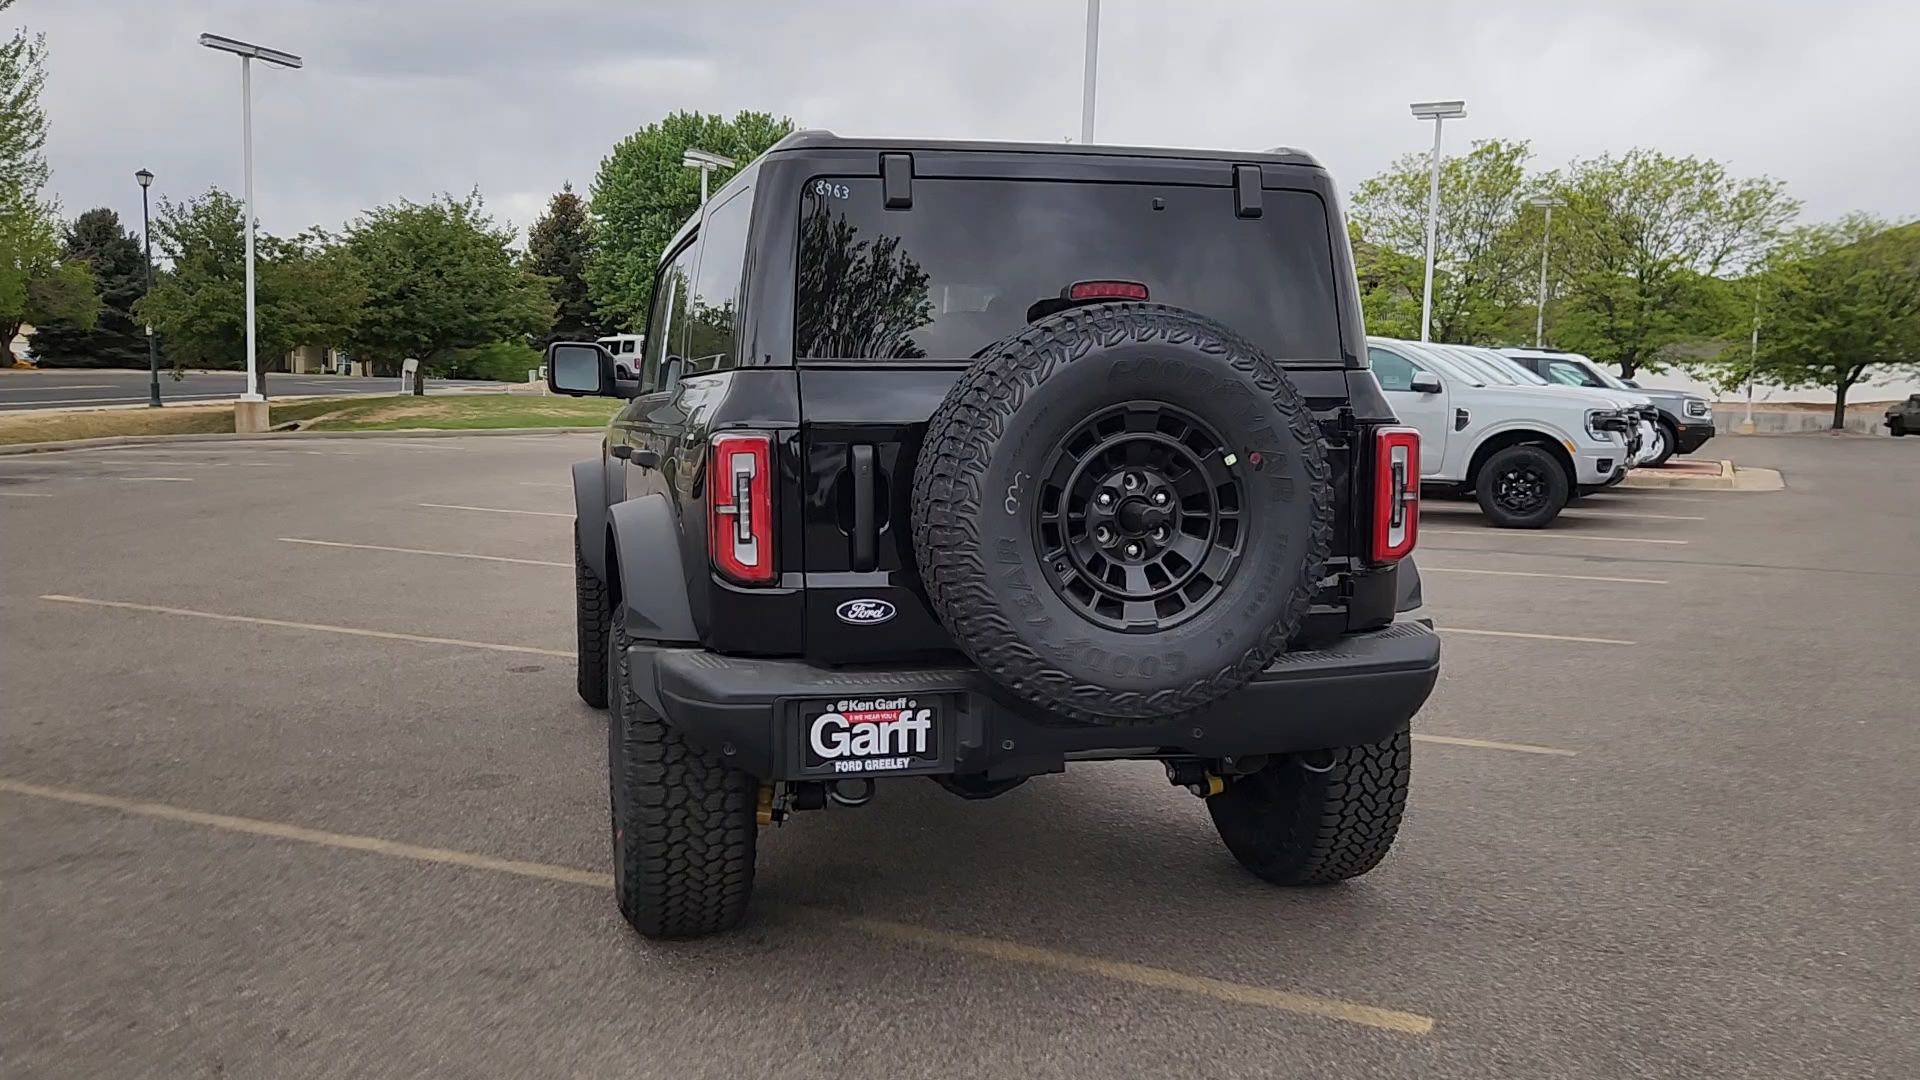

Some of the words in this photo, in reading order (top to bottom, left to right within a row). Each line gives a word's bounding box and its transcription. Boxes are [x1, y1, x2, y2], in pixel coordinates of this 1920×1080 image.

[815, 180, 850, 199] 8963
[847, 602, 885, 619] Ford
[848, 699, 874, 711] Ken
[874, 697, 907, 710] Garff
[810, 709, 931, 758] Garff
[835, 760, 863, 773] FORD
[864, 757, 911, 771] GREELEY
